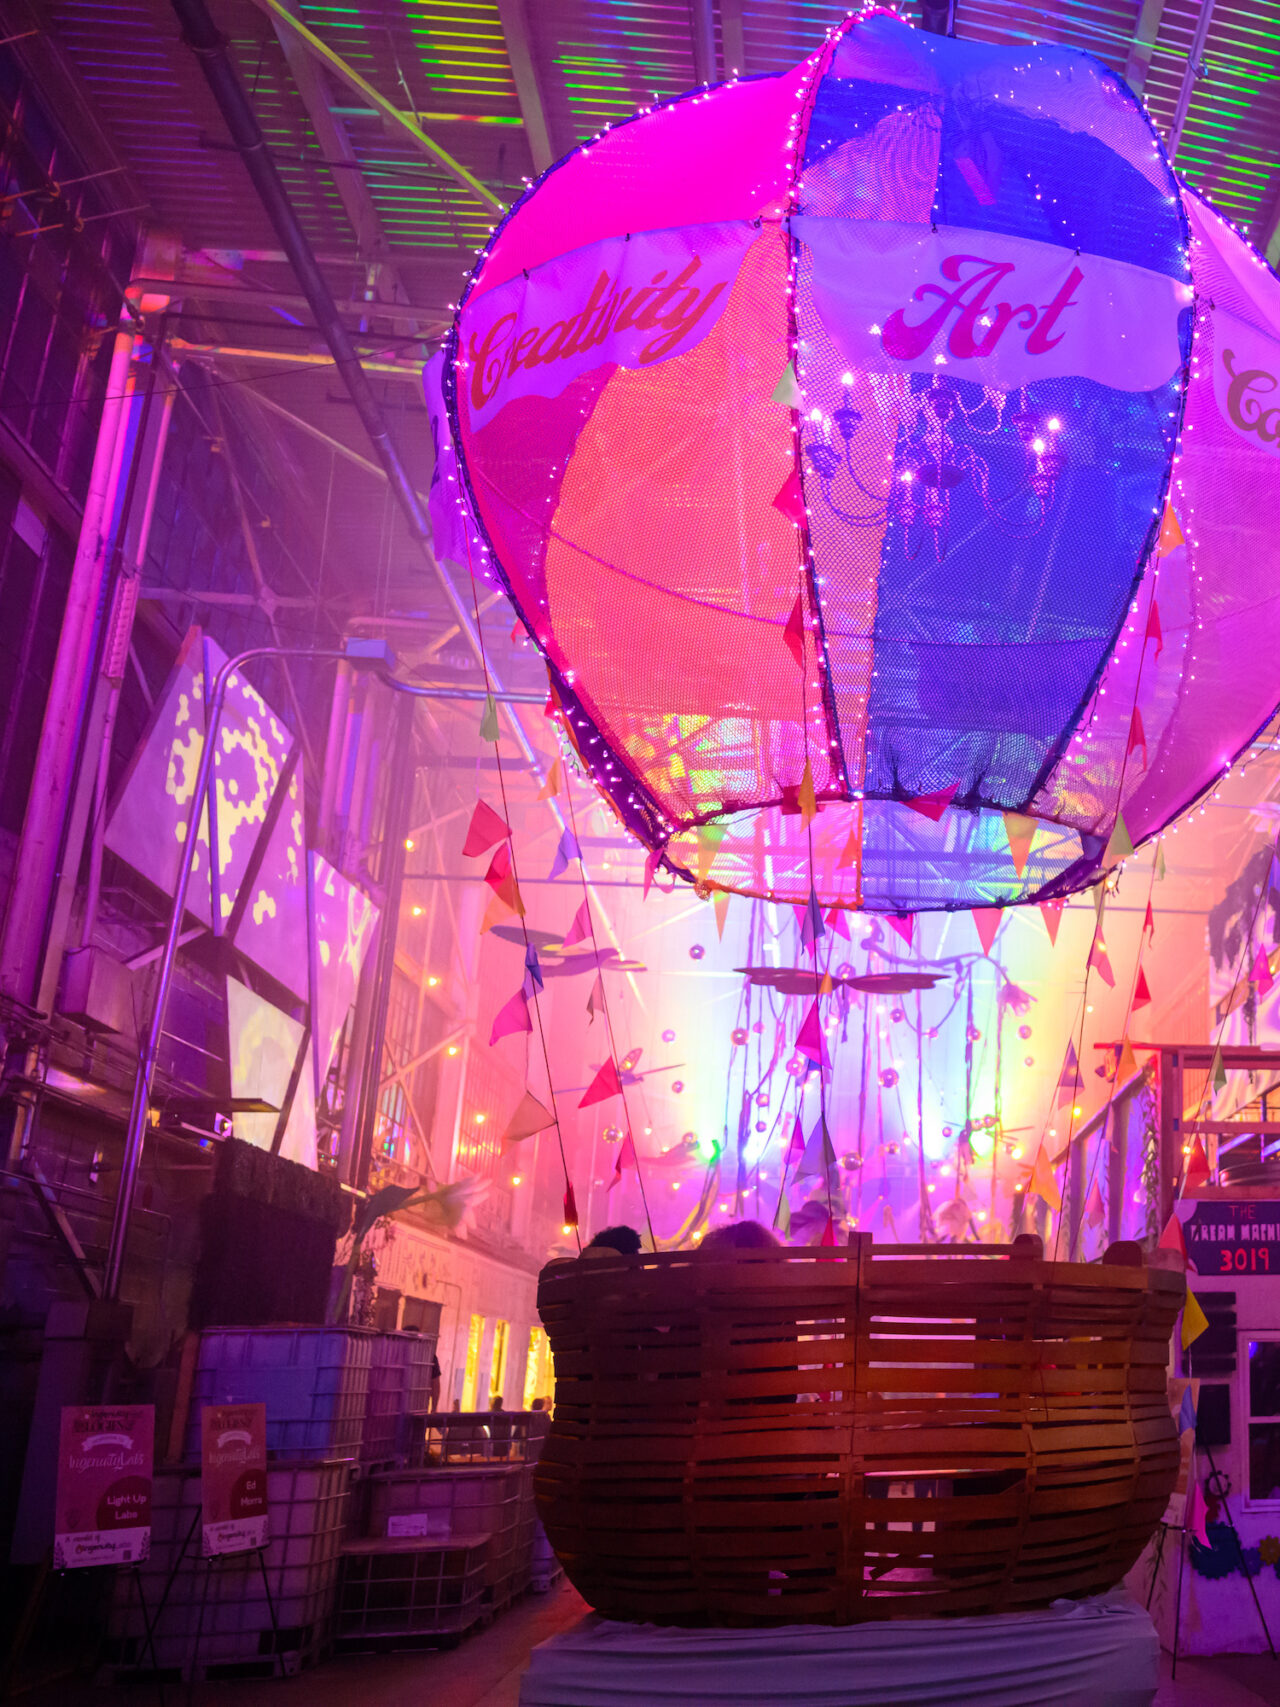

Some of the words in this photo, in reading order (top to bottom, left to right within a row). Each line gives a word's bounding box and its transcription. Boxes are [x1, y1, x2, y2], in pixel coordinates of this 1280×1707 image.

[881, 254, 1084, 361] Art
[468, 255, 728, 411] Creativity
[1228, 1205, 1256, 1219] THE
[1220, 1248, 1270, 1271] 3019
[107, 1495, 131, 1507] Light
[133, 1494, 147, 1505] Up
